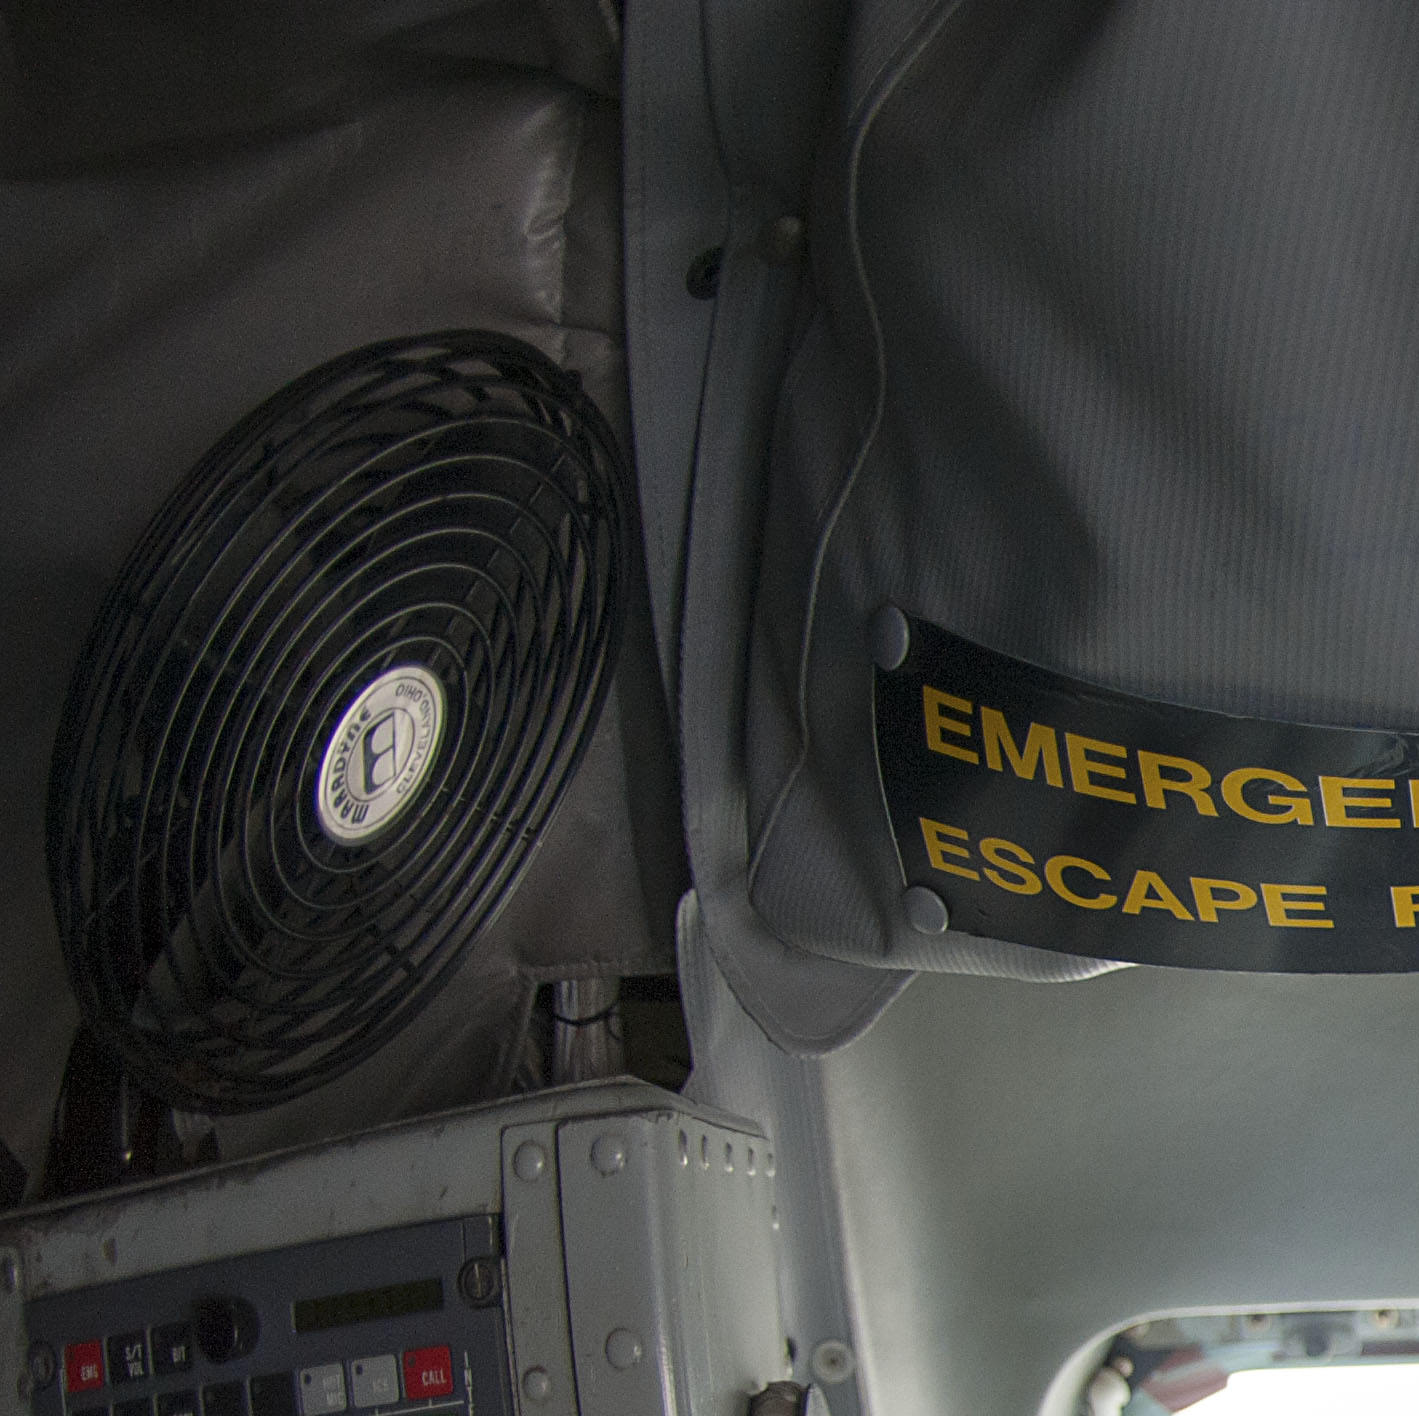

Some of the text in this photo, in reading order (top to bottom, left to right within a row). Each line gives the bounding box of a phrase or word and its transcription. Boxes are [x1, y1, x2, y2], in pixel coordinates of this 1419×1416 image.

[918, 816, 1336, 930] ESCAPE
[125, 1343, 142, 1361] S/T
[420, 1369, 448, 1387] CALL
